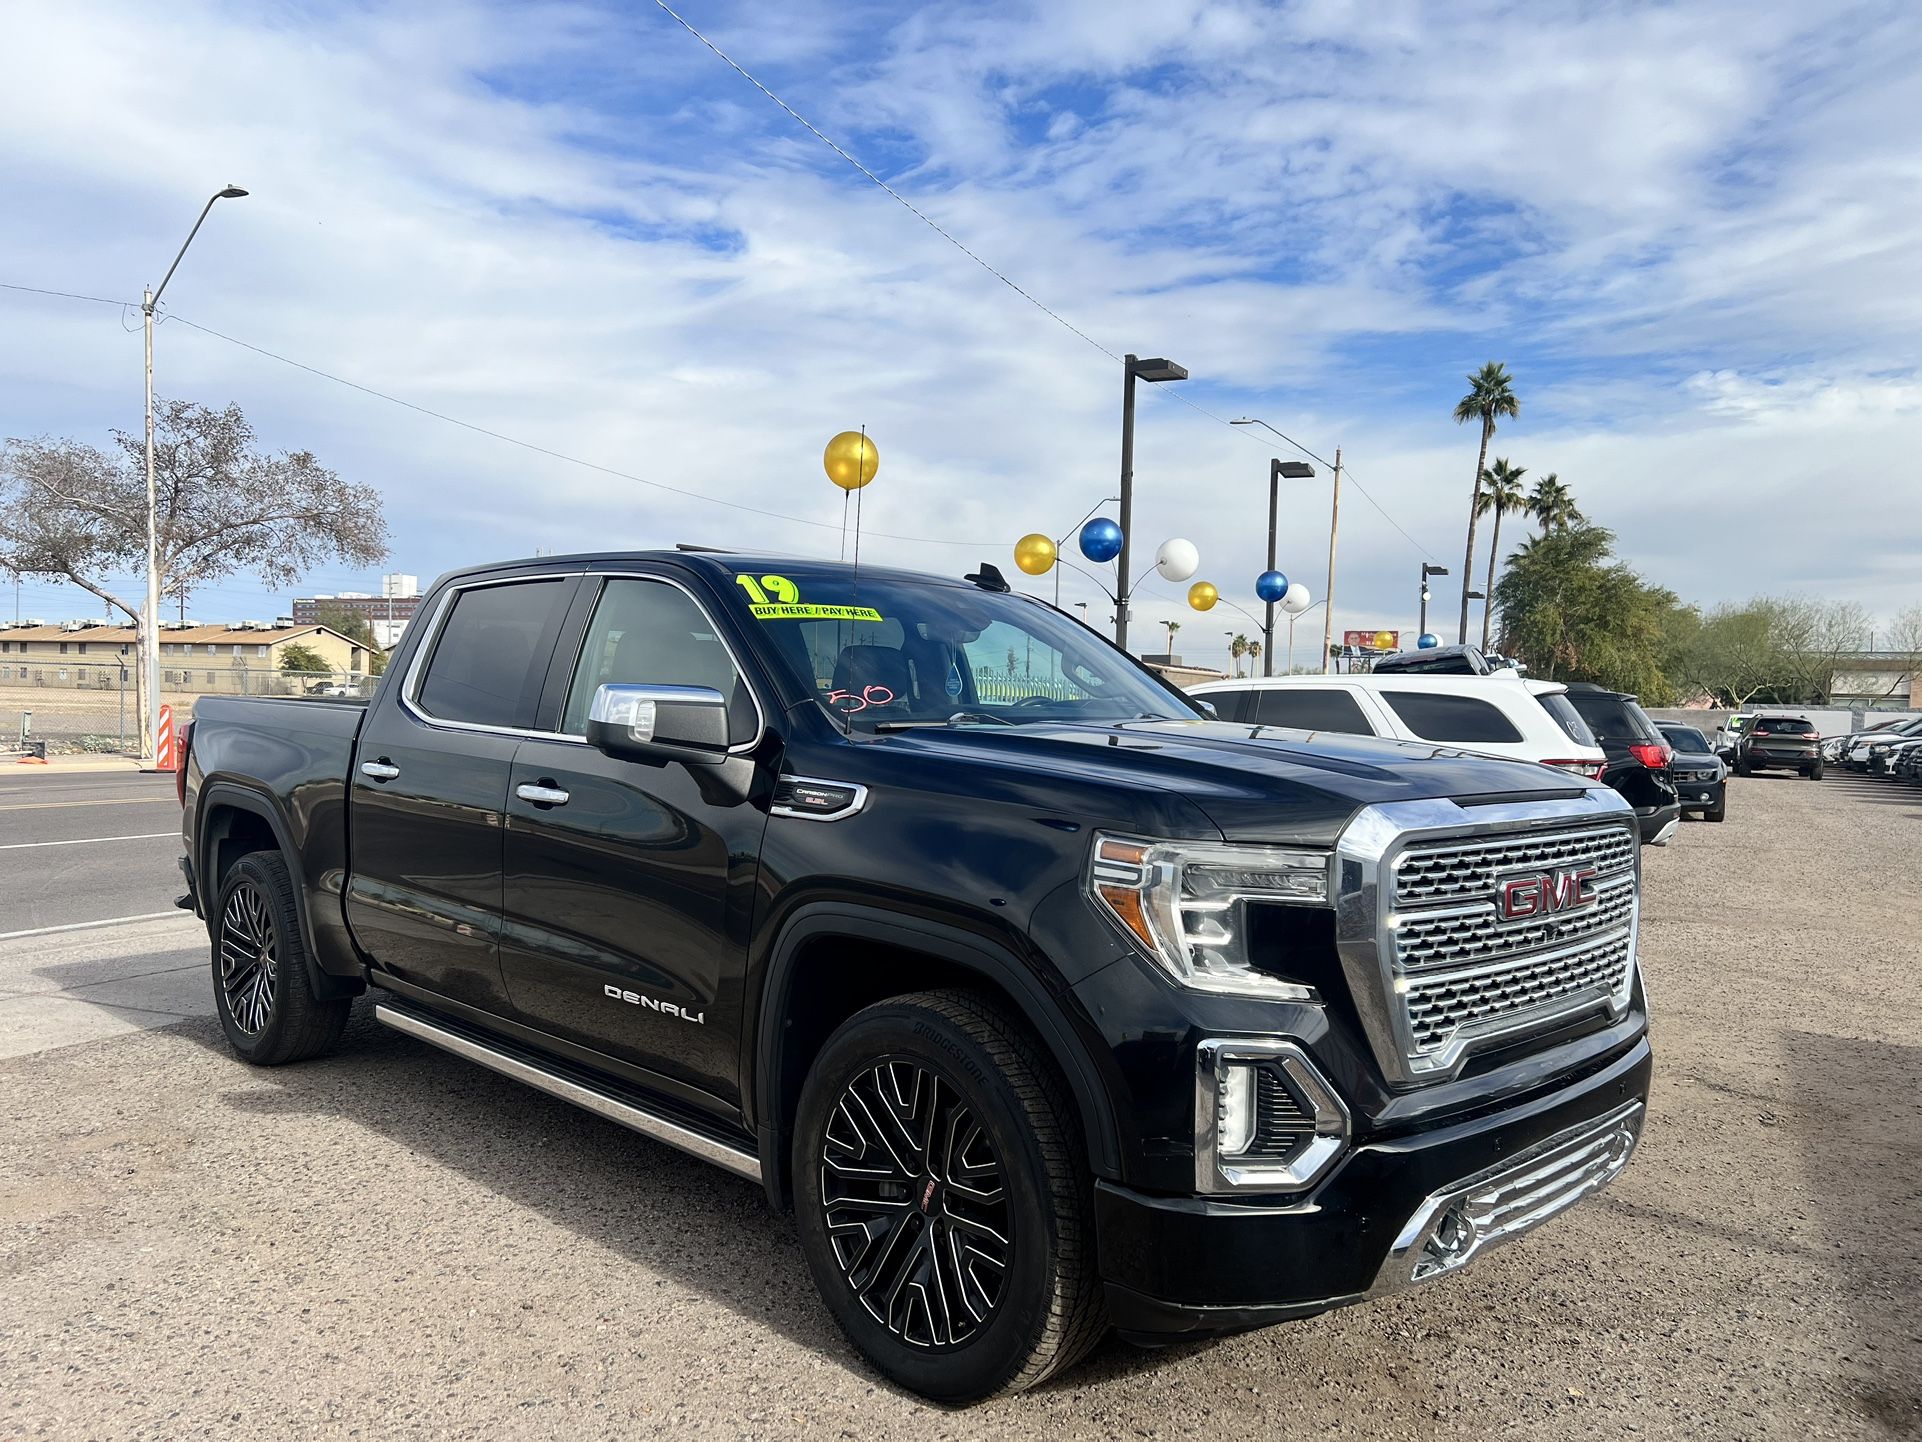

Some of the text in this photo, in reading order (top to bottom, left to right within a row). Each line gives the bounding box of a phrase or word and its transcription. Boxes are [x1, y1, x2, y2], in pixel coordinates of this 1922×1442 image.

[736, 575, 799, 604] 19
[754, 606, 778, 615] BUY
[781, 606, 811, 615] HERE
[822, 607, 842, 615] PAY
[845, 608, 874, 617] HERE
[827, 685, 894, 713] 50
[1501, 867, 1597, 921] GMC
[604, 984, 704, 1025] DENALI
[912, 1021, 989, 1087] BRIDGESTONE
